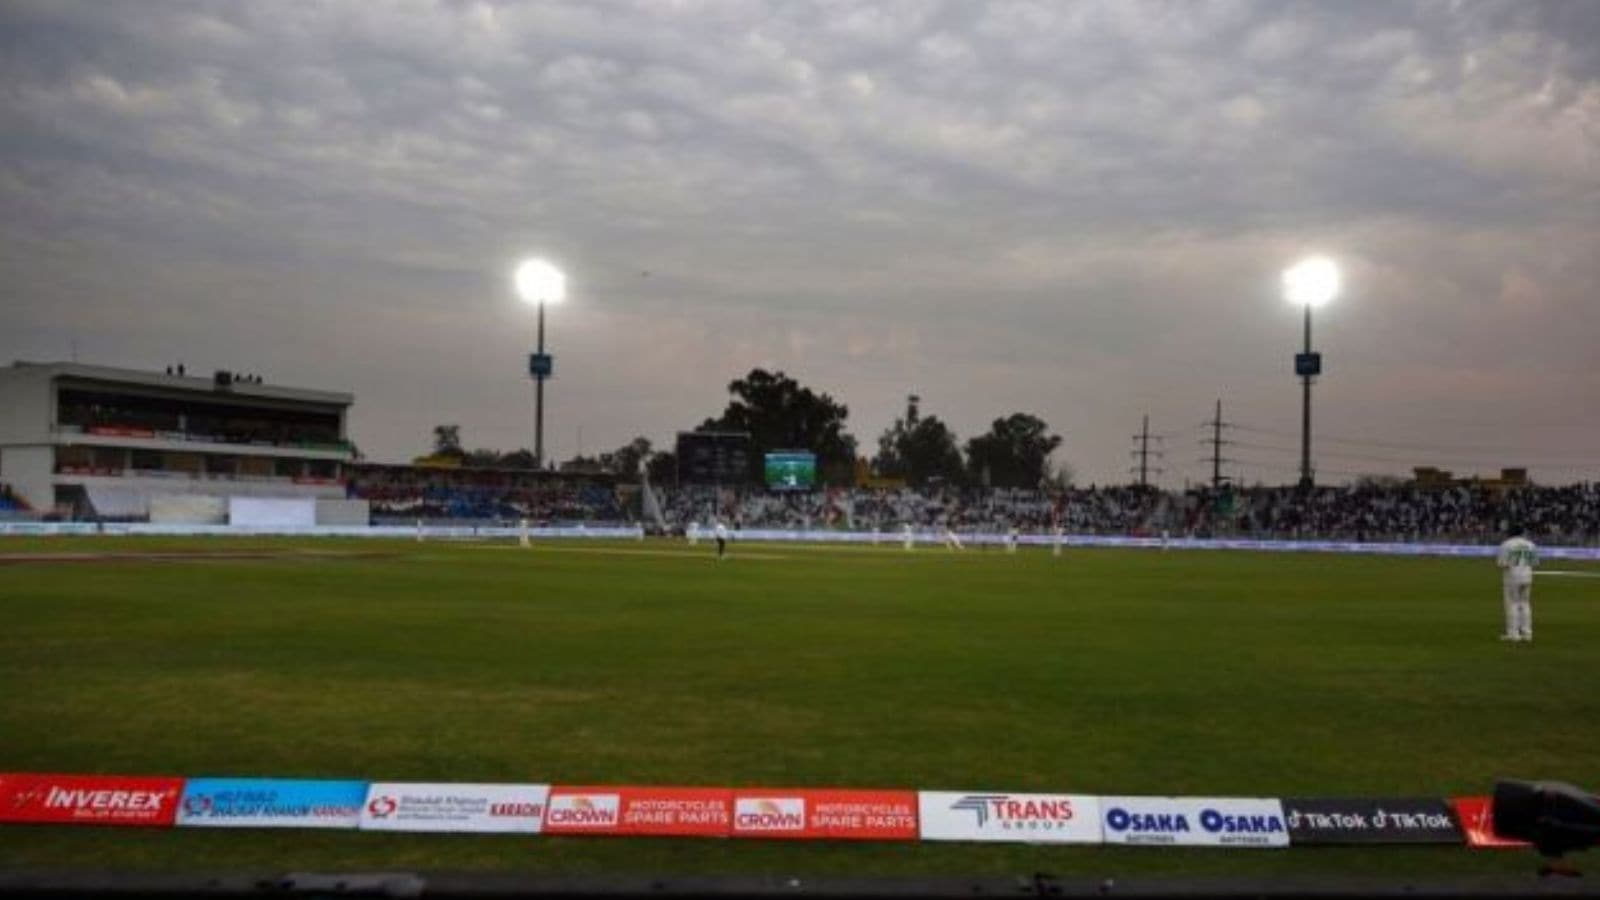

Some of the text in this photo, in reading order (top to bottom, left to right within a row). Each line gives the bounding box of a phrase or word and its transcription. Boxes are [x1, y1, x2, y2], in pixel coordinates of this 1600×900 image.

[44, 785, 165, 809] INVEREX
[489, 803, 542, 817] KARACHI
[550, 809, 613, 823] CROWN
[992, 800, 1073, 820] TRANS
[624, 811, 729, 824] SPARE PARTS
[736, 814, 801, 829] CROWN
[811, 816, 915, 829] SPARE PARTS
[1305, 813, 1454, 828] TikTok TikTok
[1002, 821, 1065, 830] GROUP
